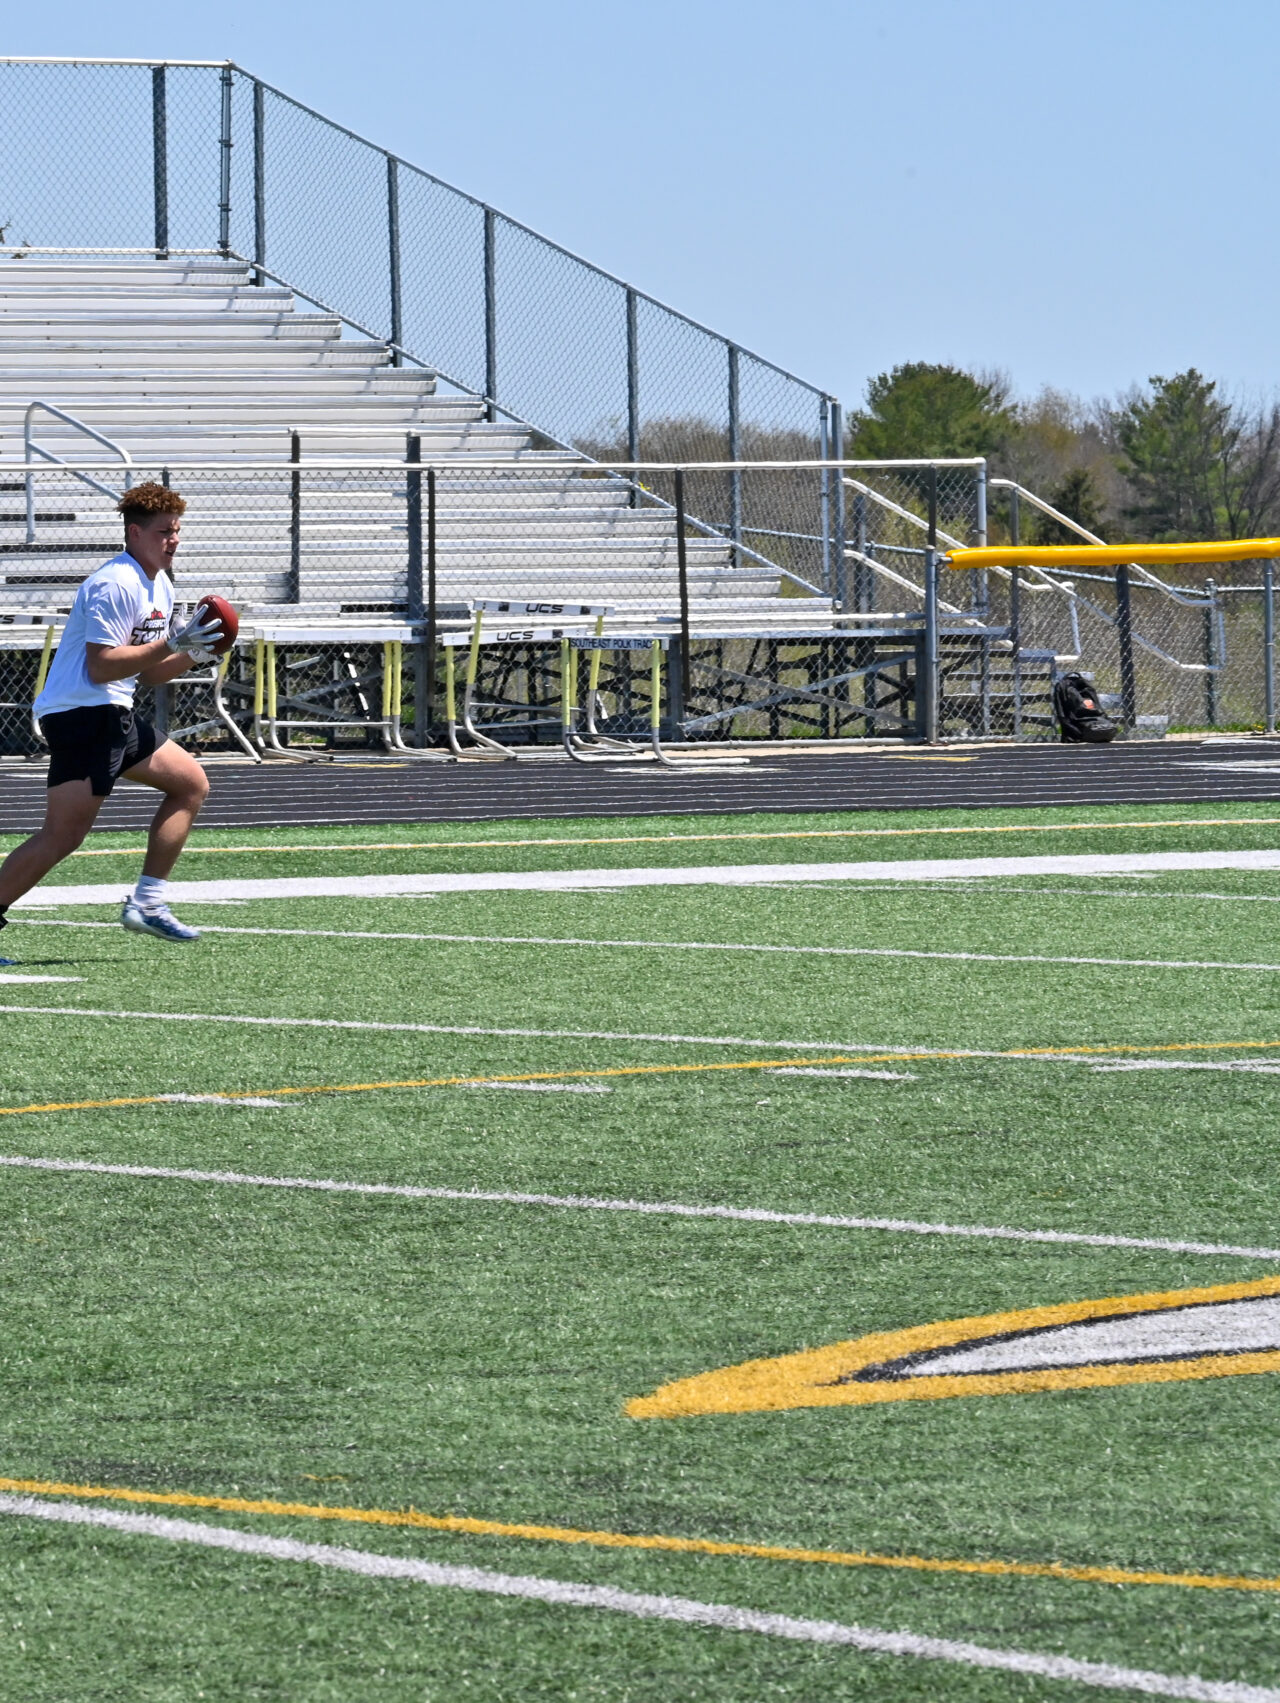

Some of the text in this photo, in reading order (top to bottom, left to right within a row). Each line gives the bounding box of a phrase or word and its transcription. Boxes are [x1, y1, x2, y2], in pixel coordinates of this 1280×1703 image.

[525, 602, 564, 613] UCS
[496, 630, 535, 641] UCS
[570, 638, 653, 650] SOUTHEAST POLK TRAC
